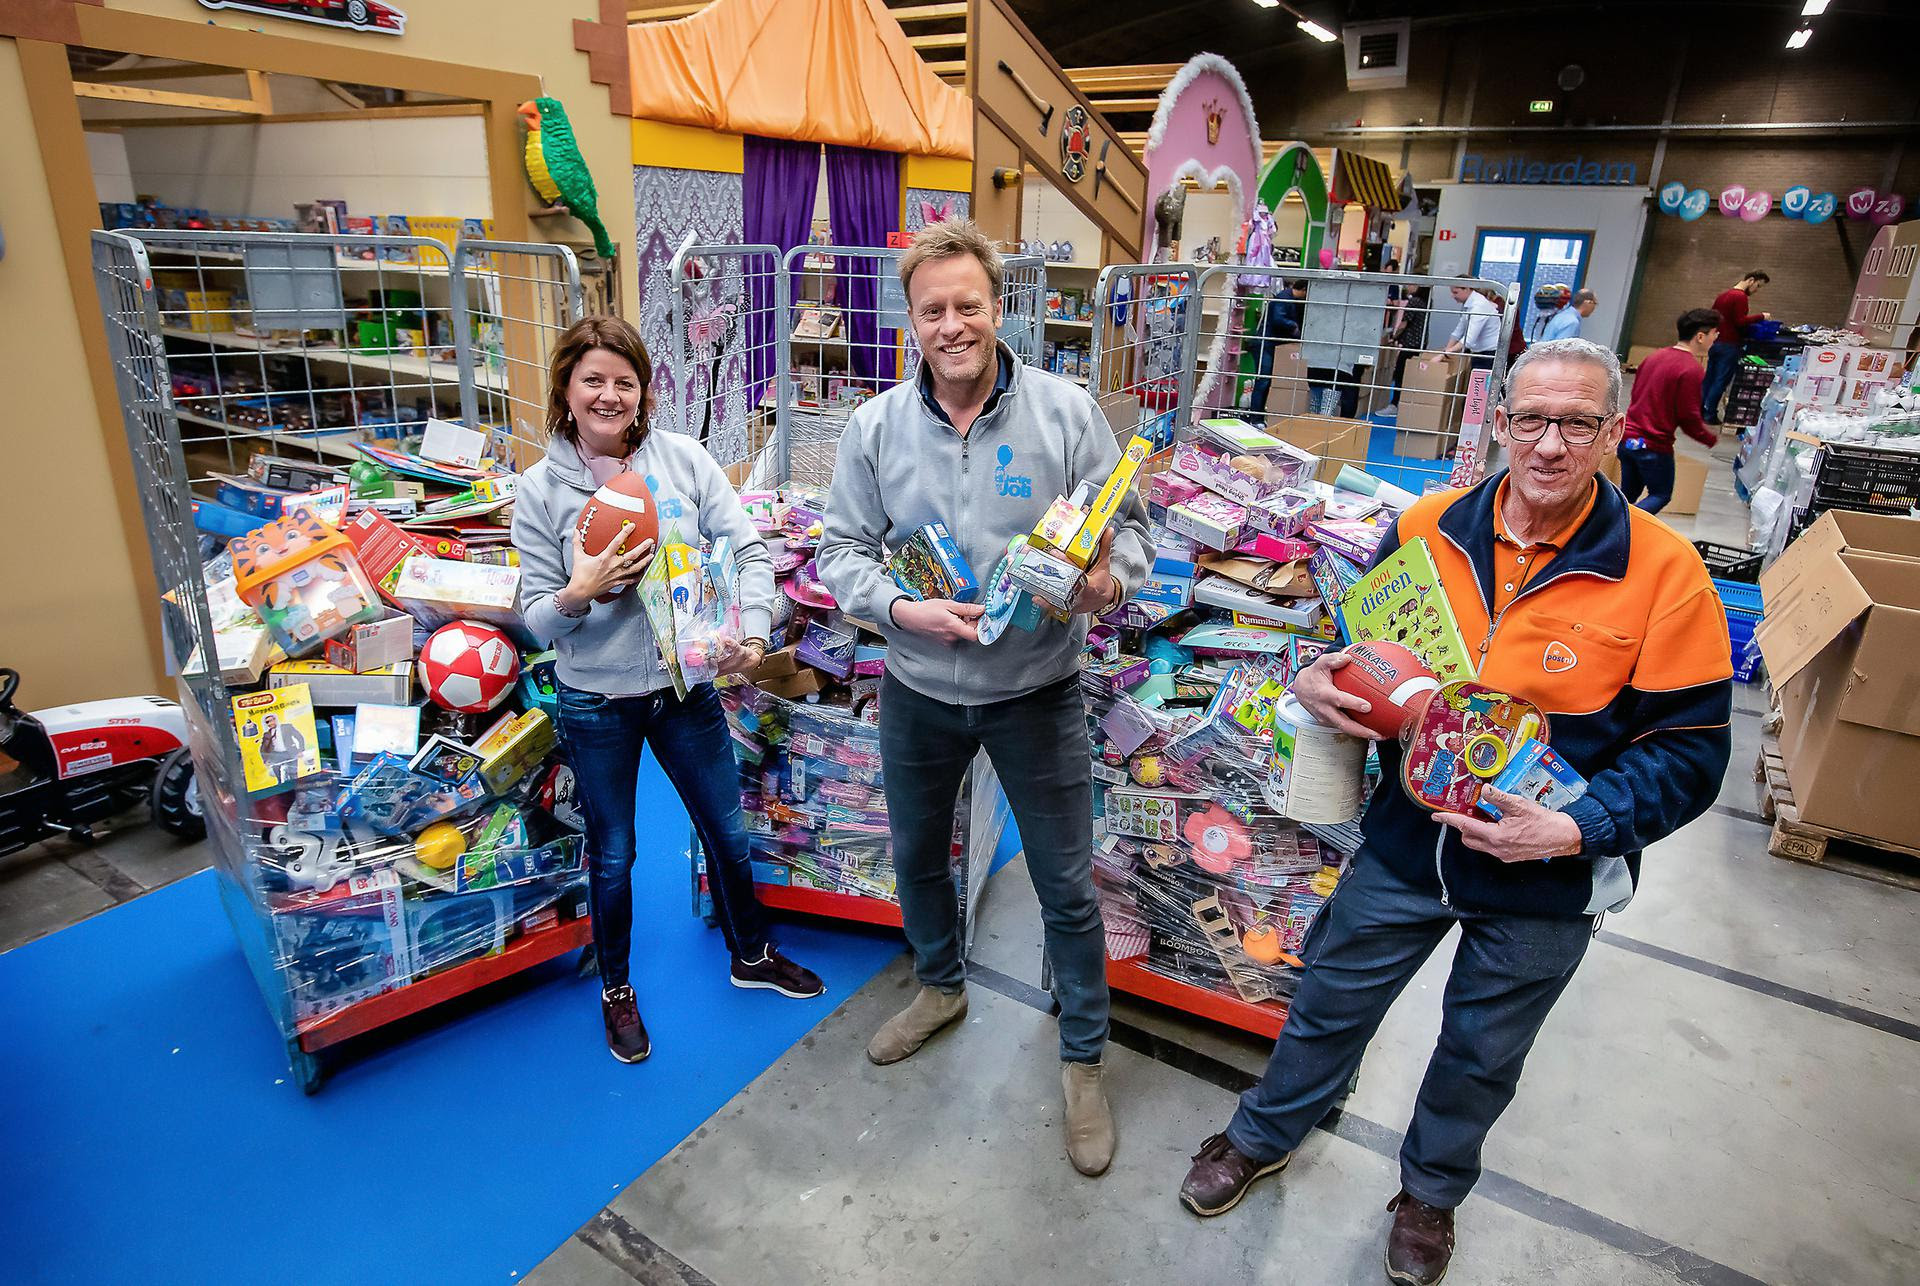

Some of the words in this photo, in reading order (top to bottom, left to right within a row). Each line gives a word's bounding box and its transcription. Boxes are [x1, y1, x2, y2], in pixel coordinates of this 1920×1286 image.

[1459, 154, 1637, 186] Rotterdam
[1099, 490, 1114, 514] Hammer
[1113, 477, 1125, 494] Farm
[951, 565, 960, 577] CITY
[1370, 568, 1391, 592] 1001
[1361, 571, 1412, 617] dieren
[1238, 614, 1284, 628] Rummikub
[1351, 645, 1400, 681] MIKASA
[107, 717, 141, 725] STEYR
[1523, 752, 1534, 765] CITY
[1551, 761, 1565, 774] CITY
[1159, 938, 1211, 958] BOOMBOX
